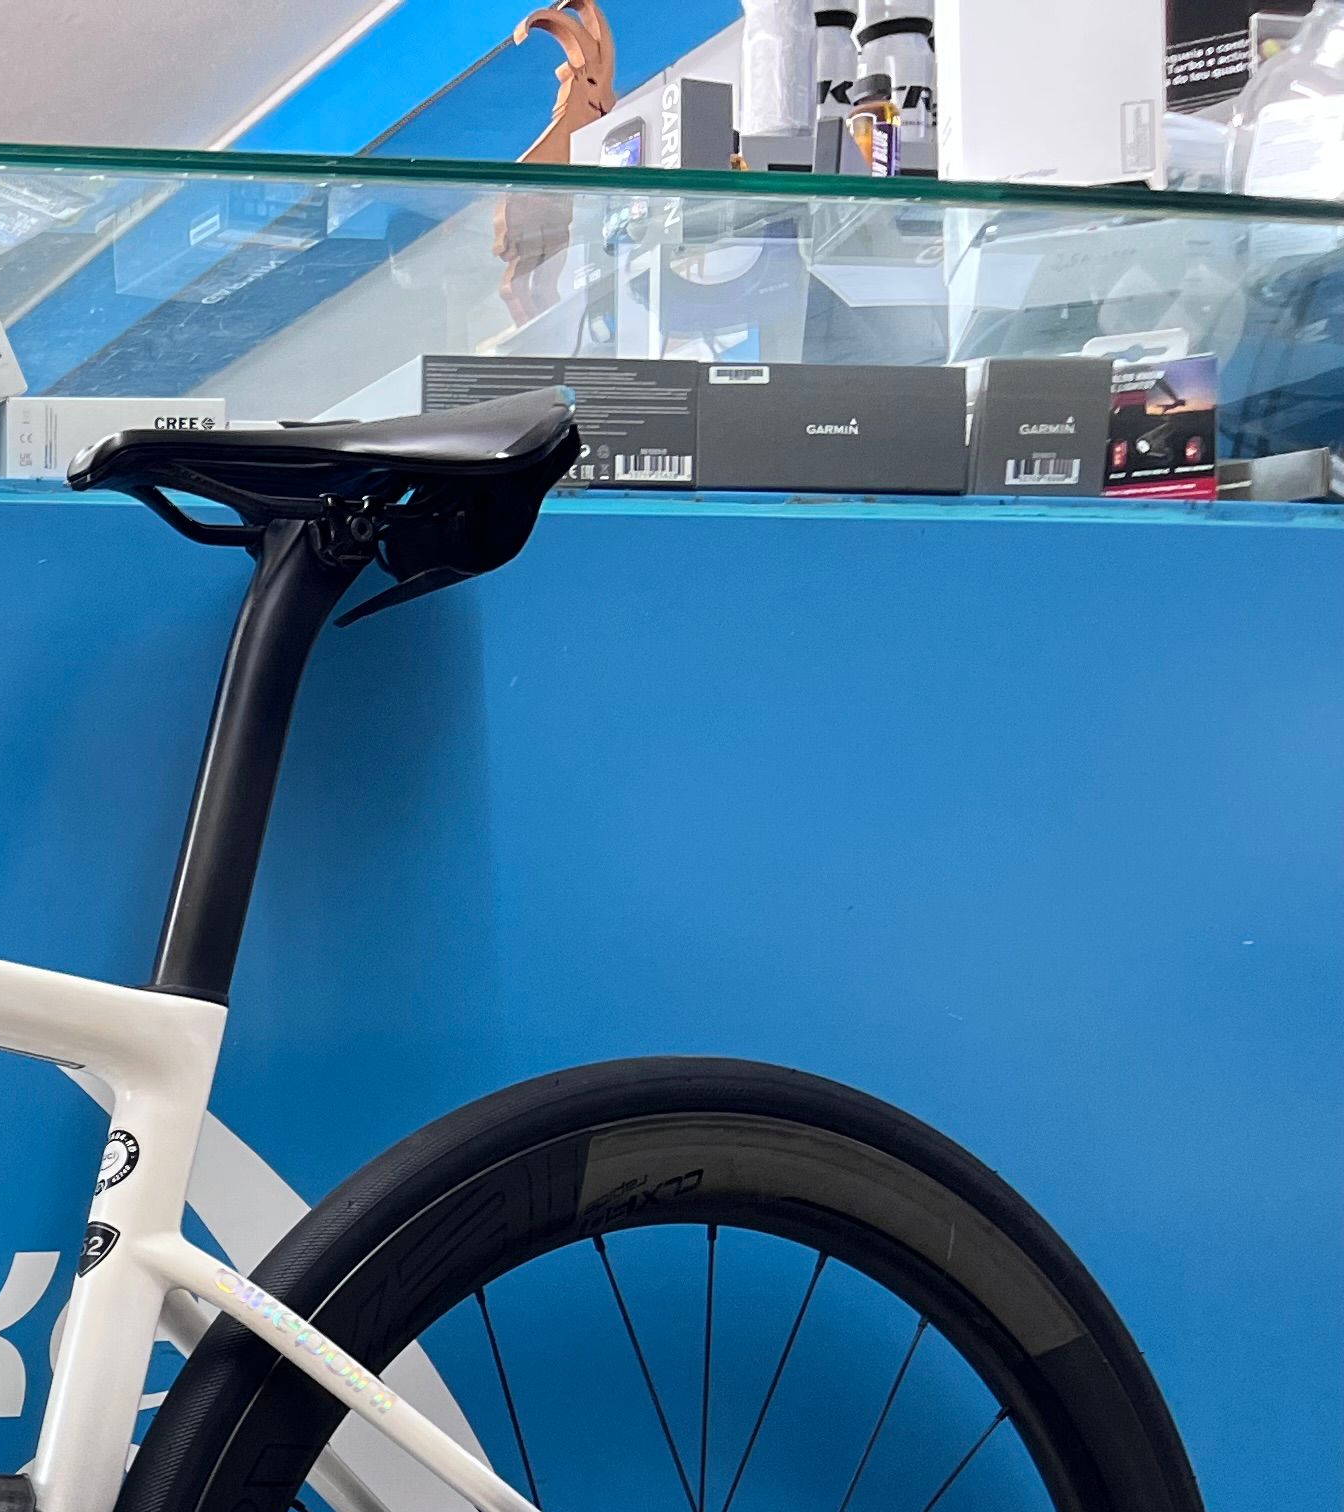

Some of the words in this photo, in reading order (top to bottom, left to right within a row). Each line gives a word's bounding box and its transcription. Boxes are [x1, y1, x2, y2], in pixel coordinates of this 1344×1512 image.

[154, 416, 199, 430] CREE
[806, 419, 859, 435] GARMIN
[1019, 419, 1076, 435] GARMIN
